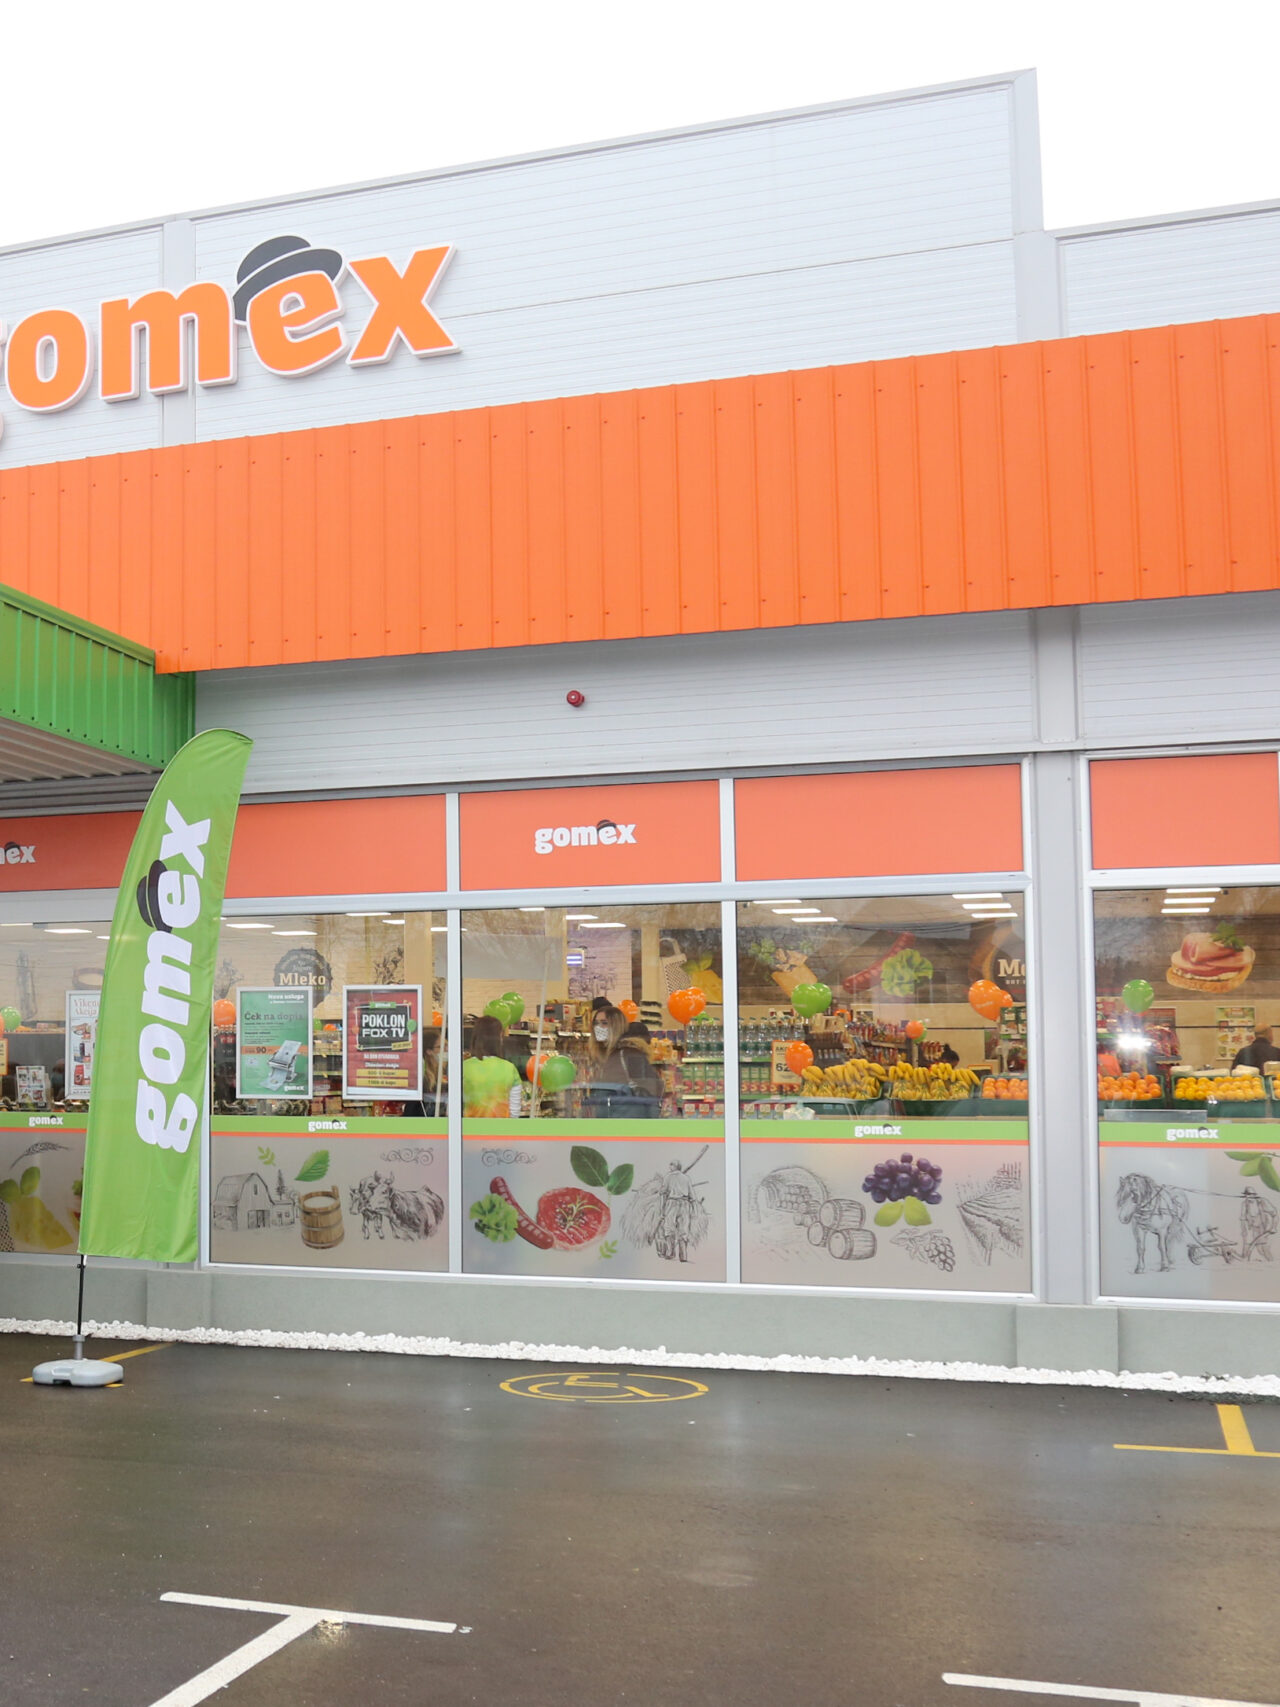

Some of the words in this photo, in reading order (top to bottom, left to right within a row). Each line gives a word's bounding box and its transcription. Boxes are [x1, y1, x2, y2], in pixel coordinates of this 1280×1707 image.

[534, 822, 637, 854] gomex
[135, 799, 211, 1153] gomex
[279, 972, 326, 986] Mleko
[244, 1010, 261, 1021] Ček
[362, 1014, 406, 1027] POKLON
[362, 1028, 388, 1038] FOX
[391, 1028, 406, 1038] TV
[256, 1046, 267, 1054] 90
[28, 1115, 64, 1127] gomex
[308, 1120, 347, 1132] gomex
[854, 1124, 902, 1138] gomex
[1166, 1127, 1219, 1142] gomex
